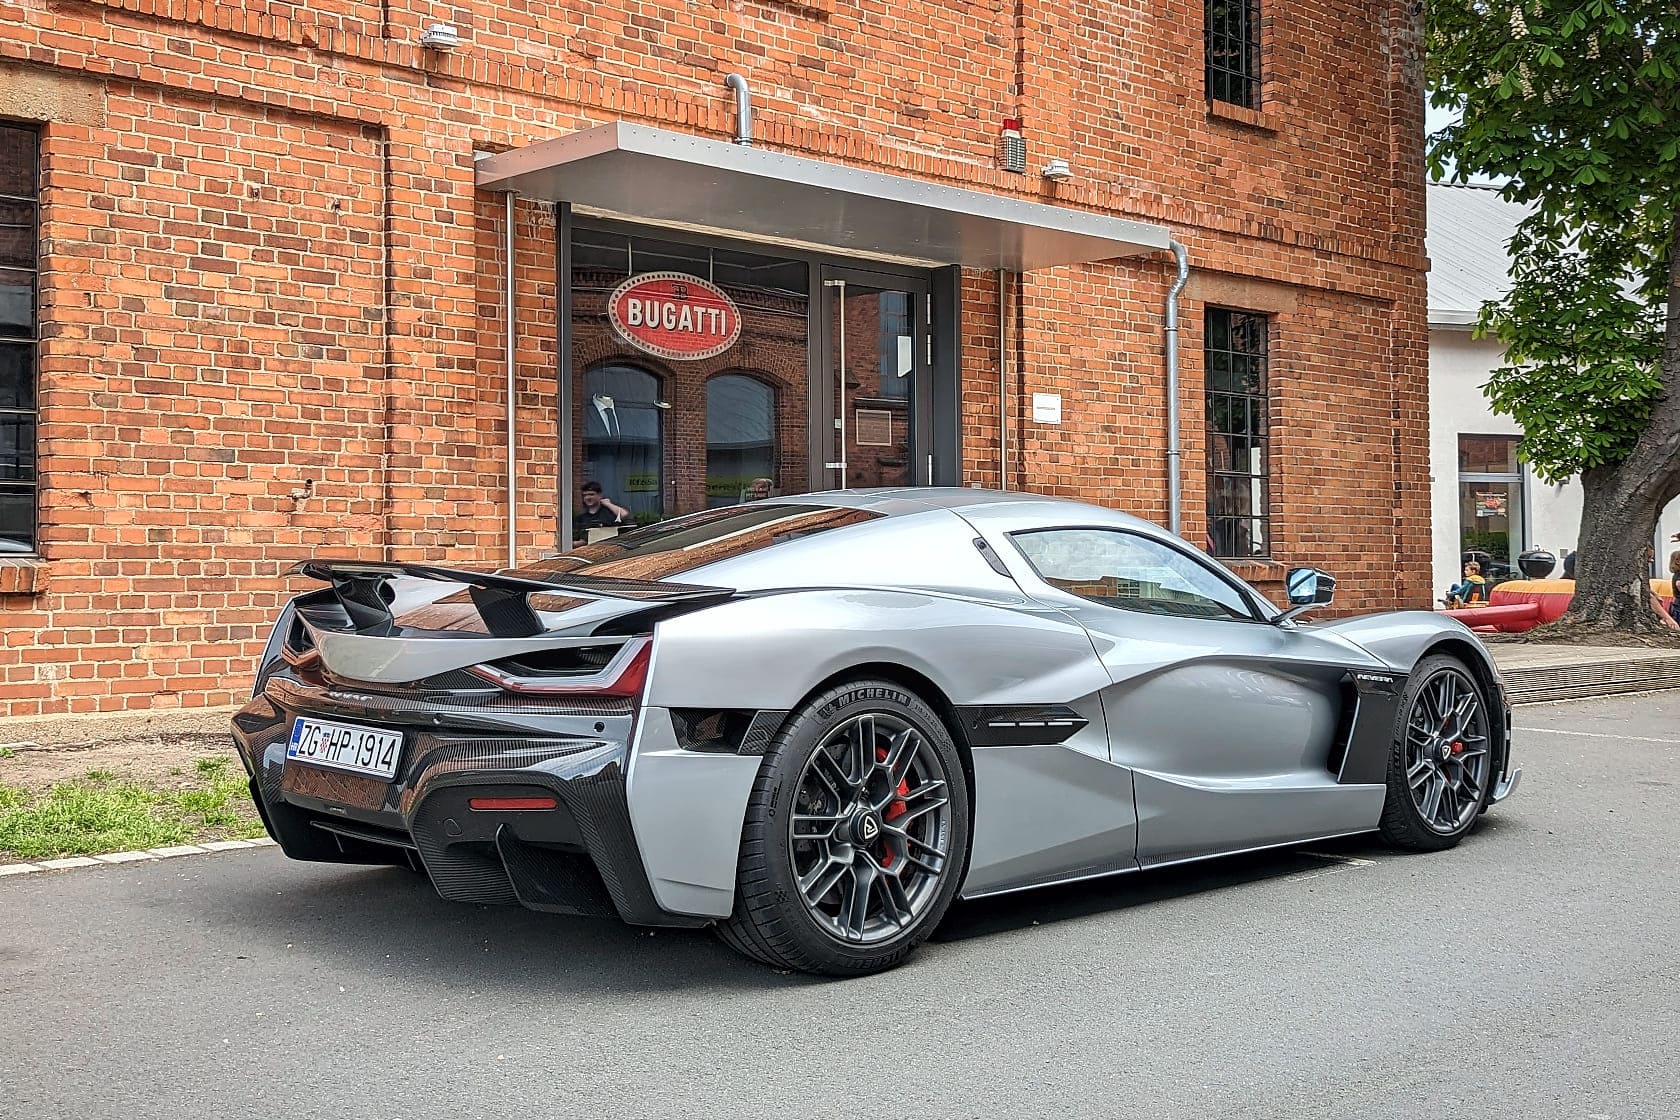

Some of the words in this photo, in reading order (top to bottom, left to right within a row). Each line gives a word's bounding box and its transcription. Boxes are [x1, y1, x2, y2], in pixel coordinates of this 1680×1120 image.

[627, 298, 727, 336] BUGATTI
[838, 688, 908, 707] MICHELIN
[298, 724, 321, 757] ZG
